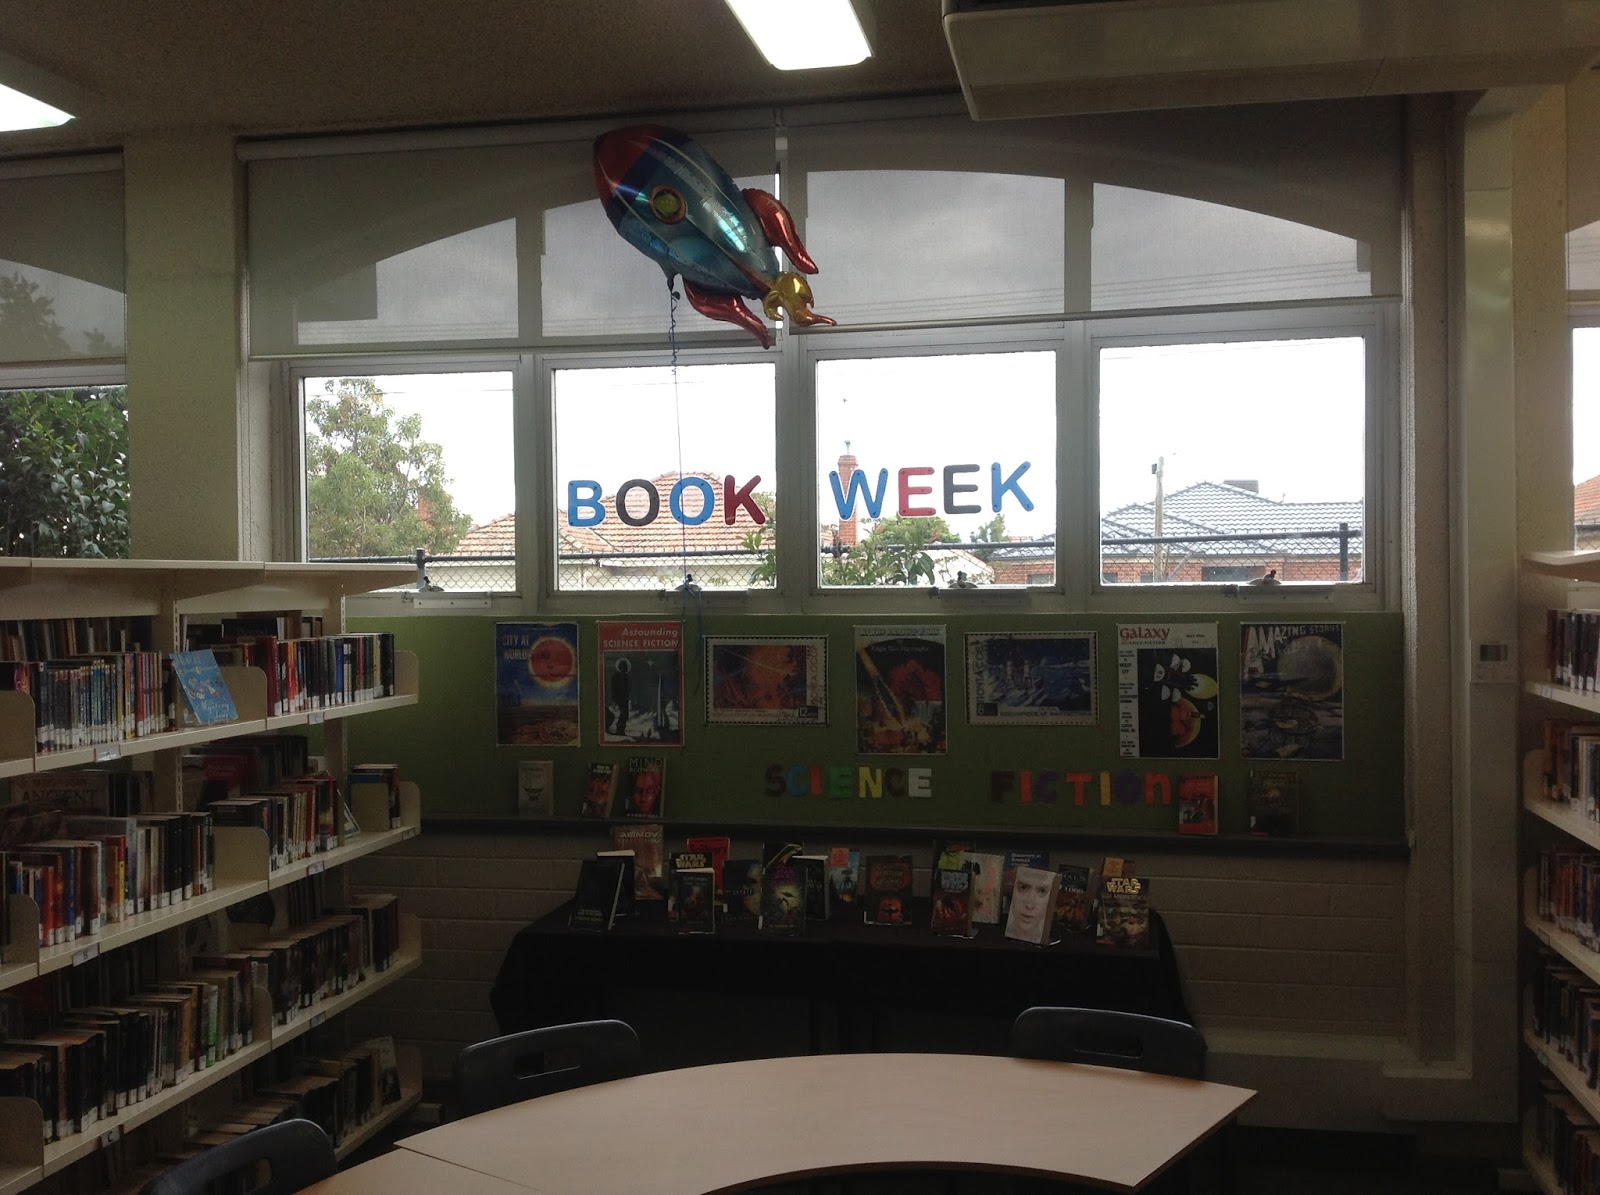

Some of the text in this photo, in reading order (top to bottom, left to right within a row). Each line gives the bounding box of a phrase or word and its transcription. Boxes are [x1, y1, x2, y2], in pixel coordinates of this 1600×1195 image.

[567, 461, 1035, 528] BOOK WEEK
[621, 627, 679, 638] Astounding
[1119, 626, 1170, 640] Galaxy
[602, 639, 679, 648] SCIENCE FICTION
[1243, 624, 1340, 681] AMAZING STORIES
[977, 703, 985, 715] 6
[629, 757, 664, 768] MIND
[763, 763, 934, 799] SCIENCE
[679, 853, 705, 861] STAR
[676, 859, 706, 868] WARS
[1110, 877, 1138, 886] STAR
[1106, 883, 1142, 895] WARS
[107, 1131, 114, 1143] C
